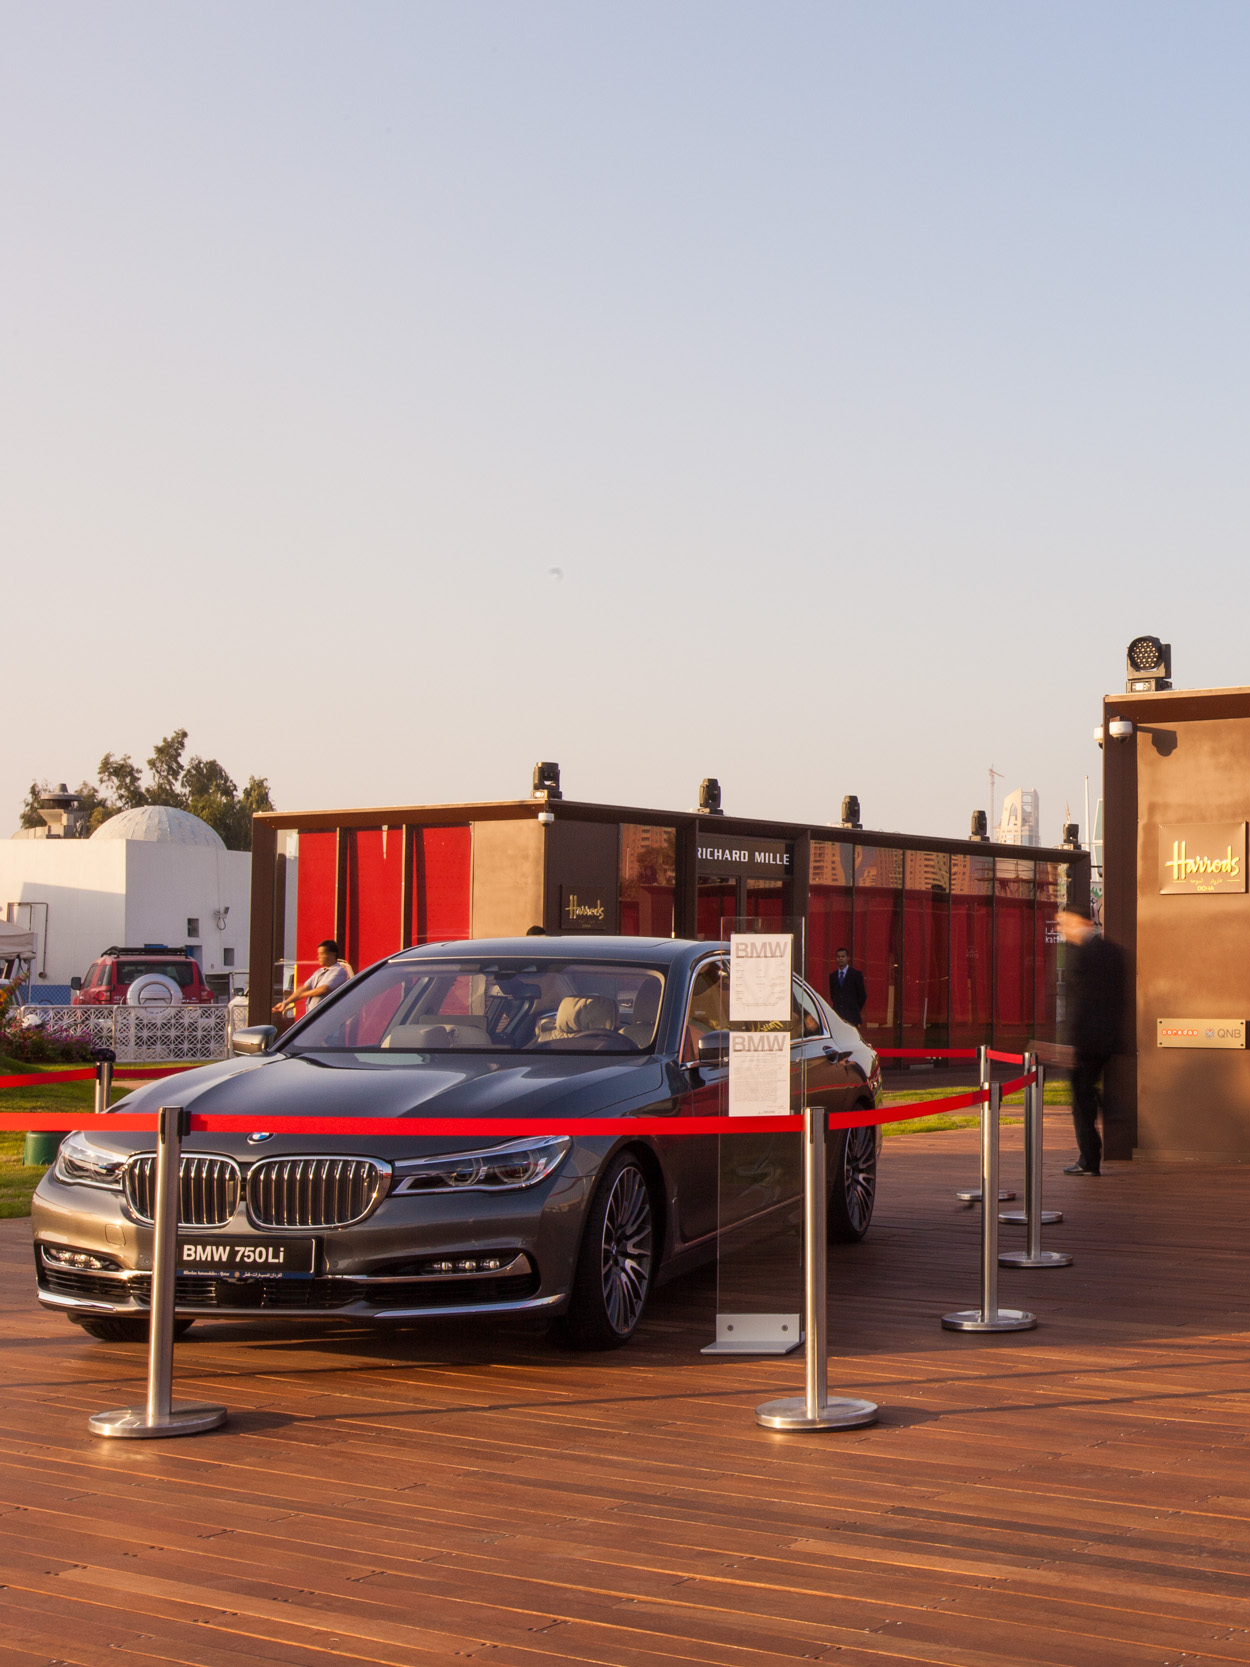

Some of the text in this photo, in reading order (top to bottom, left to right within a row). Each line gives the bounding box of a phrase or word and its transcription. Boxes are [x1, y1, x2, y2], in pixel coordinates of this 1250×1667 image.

[754, 851, 790, 865] MILLE
[1165, 840, 1240, 880] Harrods
[565, 894, 605, 919] Harrods
[735, 941, 788, 958] BMW
[1162, 1028, 1242, 1039] ooredoo QNB
[732, 1035, 787, 1052] BMW
[183, 1244, 284, 1263] BMW 750Li
